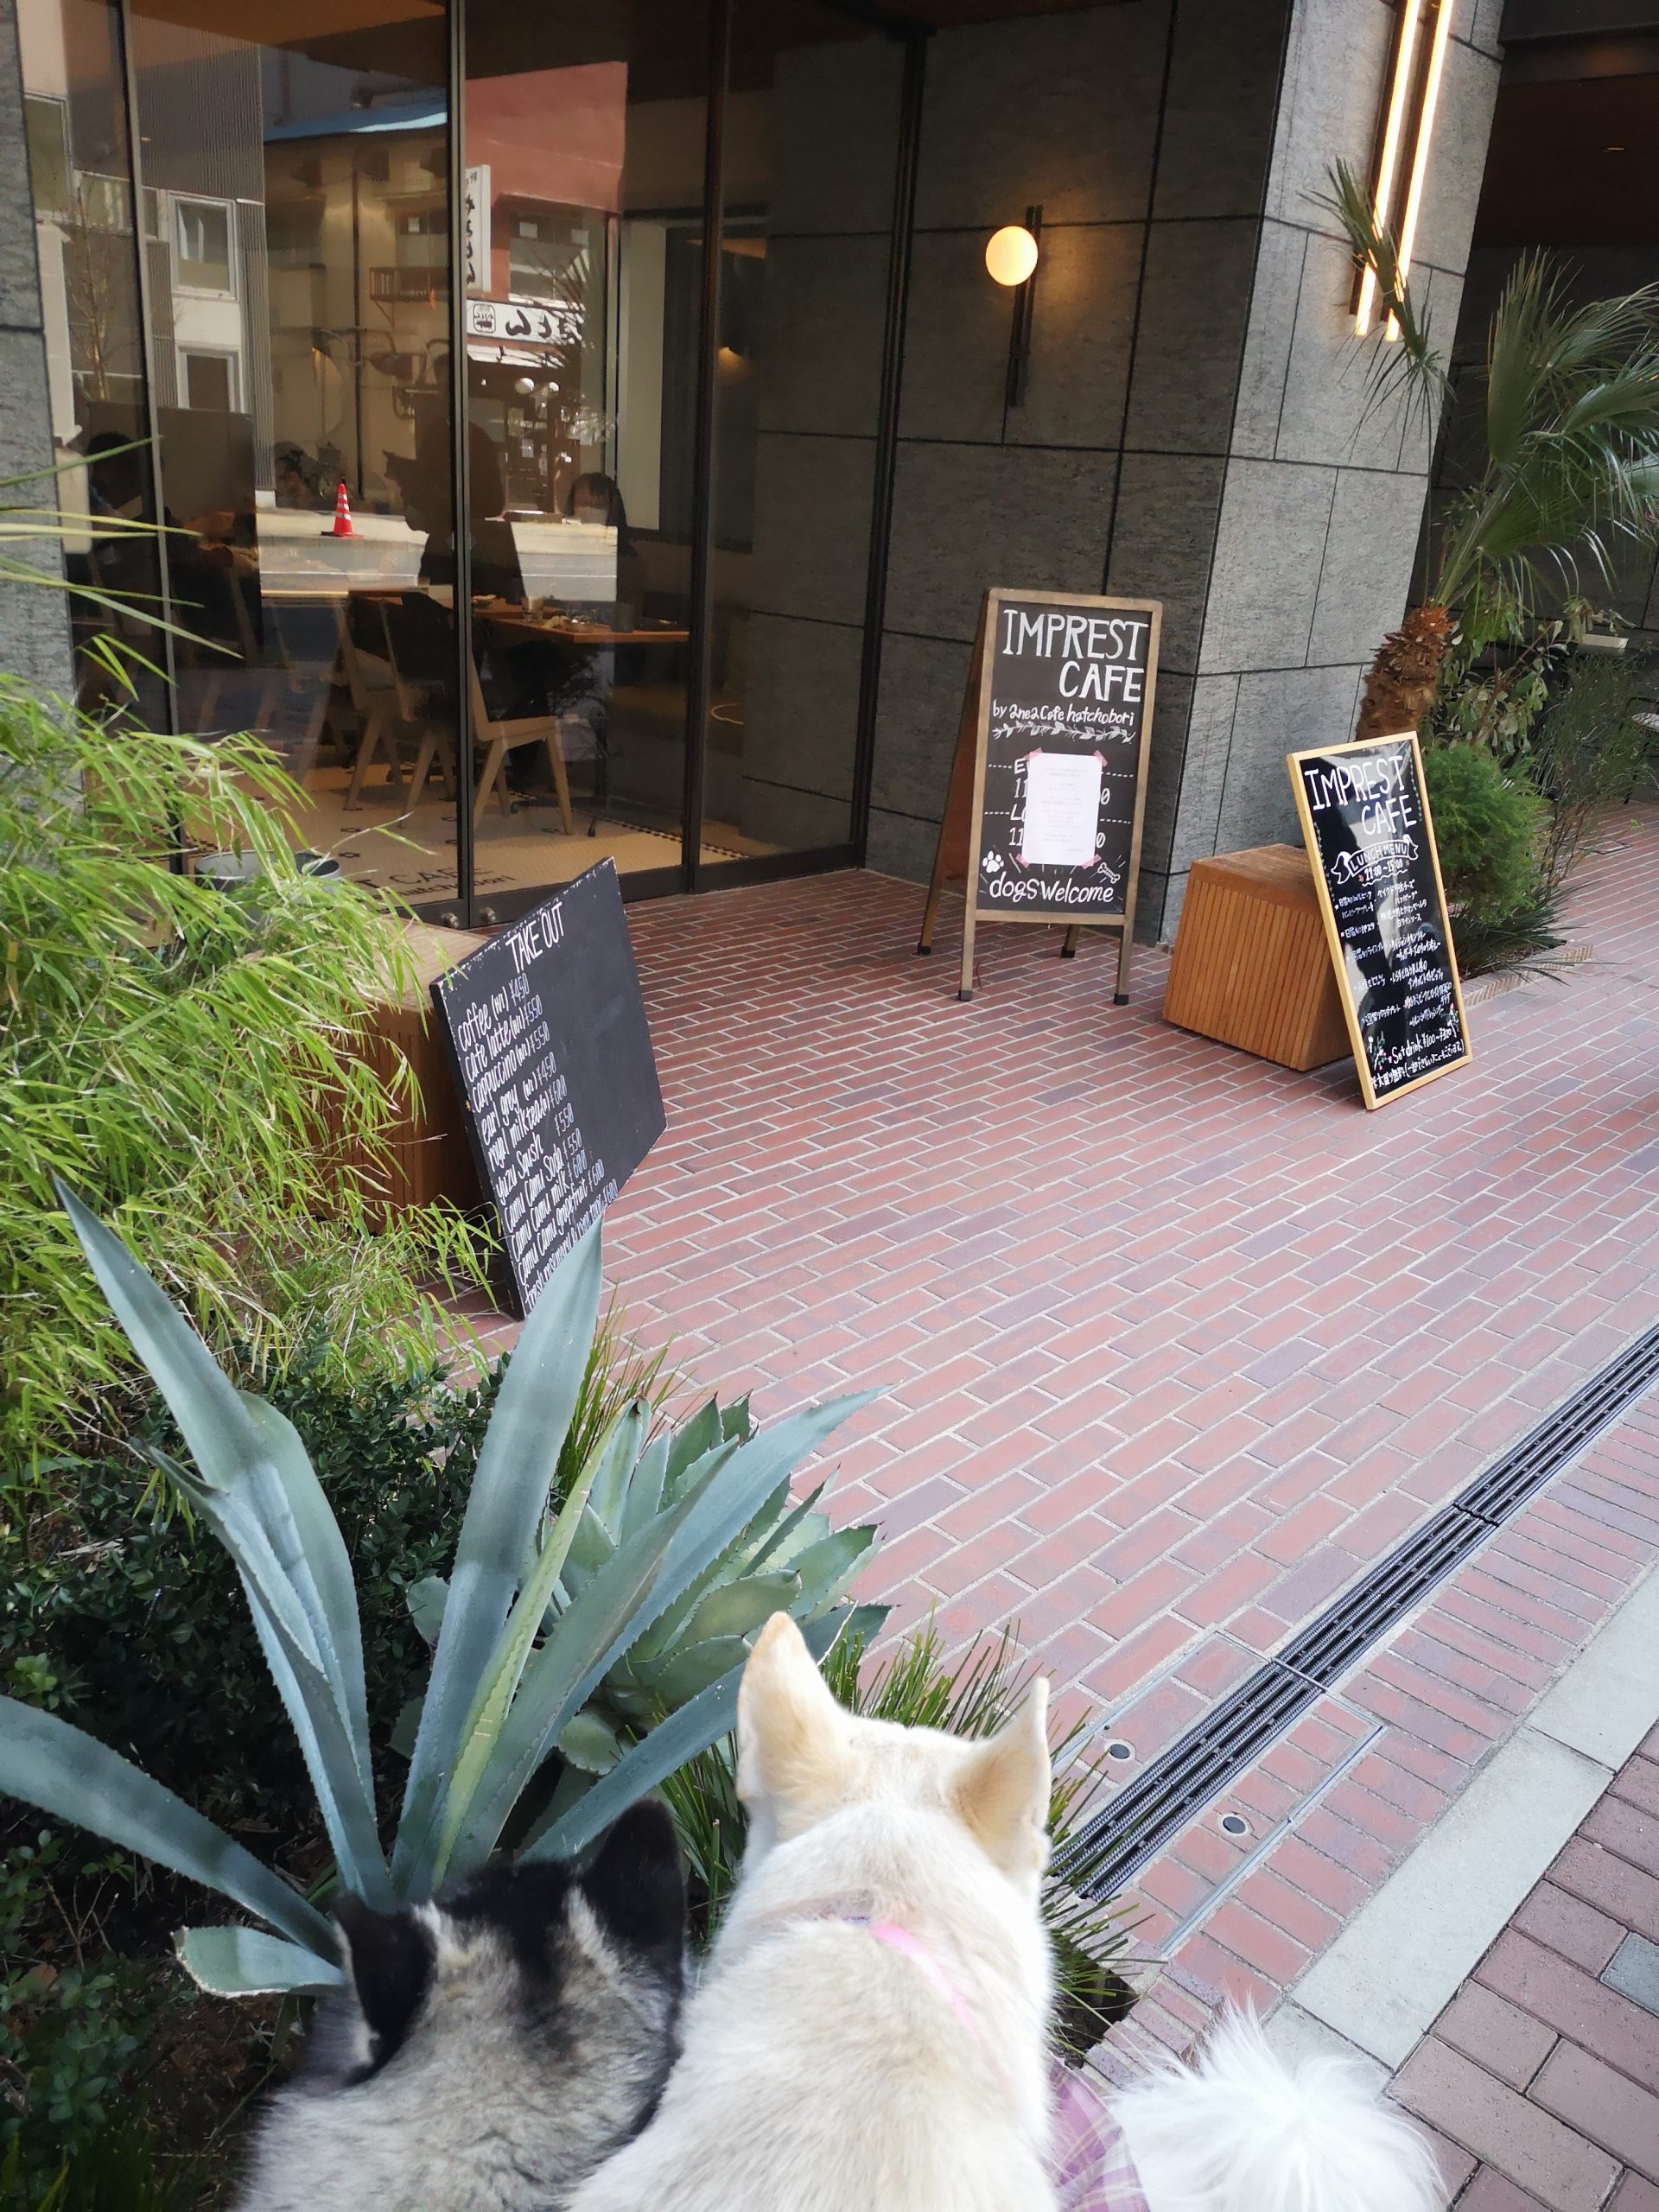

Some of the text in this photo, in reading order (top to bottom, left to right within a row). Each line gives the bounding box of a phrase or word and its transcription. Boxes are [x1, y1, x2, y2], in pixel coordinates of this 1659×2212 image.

[1002, 609, 1149, 661] IMPREST
[1058, 660, 1145, 702] CAFE
[993, 699, 1007, 719] by
[1066, 703, 1135, 726] hatchobori
[1305, 755, 1405, 810] IMPREST
[1361, 794, 1417, 836] CAFE
[1350, 842, 1407, 871] LUNCH MENU
[505, 901, 564, 974] TAKE OUT
[458, 1002, 491, 1052] coffee
[481, 1102, 500, 1145] earl
[500, 1084, 519, 1126] grey
[488, 1128, 510, 1173] royal
[496, 1164, 518, 1207] yuzu
[551, 1171, 570, 1206] milk
